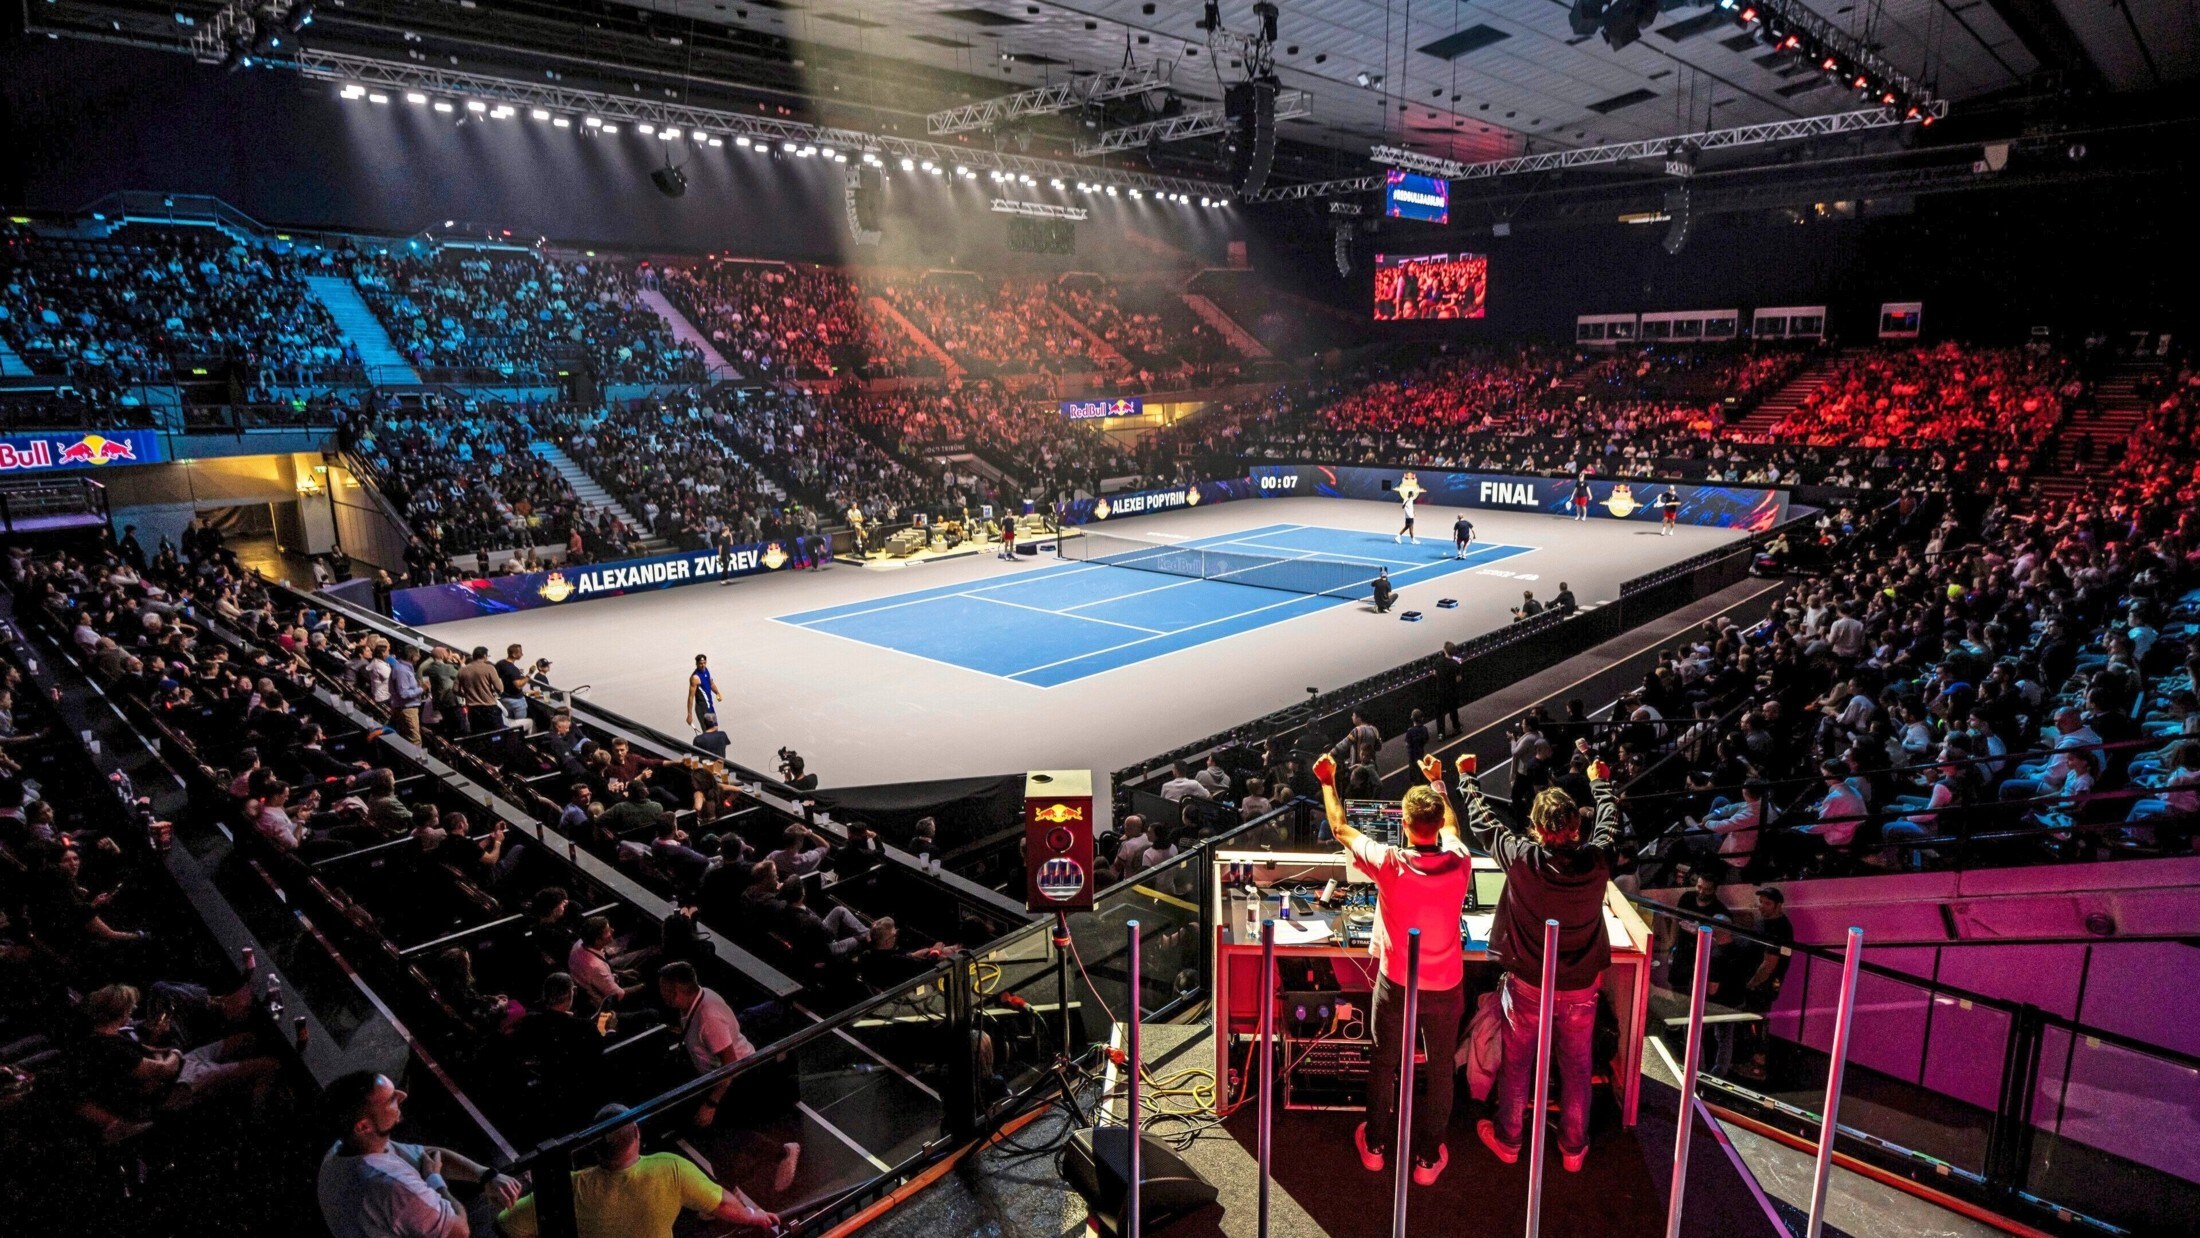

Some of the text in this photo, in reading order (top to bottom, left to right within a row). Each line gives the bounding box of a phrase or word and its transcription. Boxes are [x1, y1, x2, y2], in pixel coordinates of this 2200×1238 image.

[0, 439, 52, 470] Bull
[1260, 475, 1298, 490] 00:07
[1480, 481, 1539, 507] FINAL
[1112, 490, 1186, 515] ALEXEI POPYRIN
[578, 559, 690, 594] ALEXANDER
